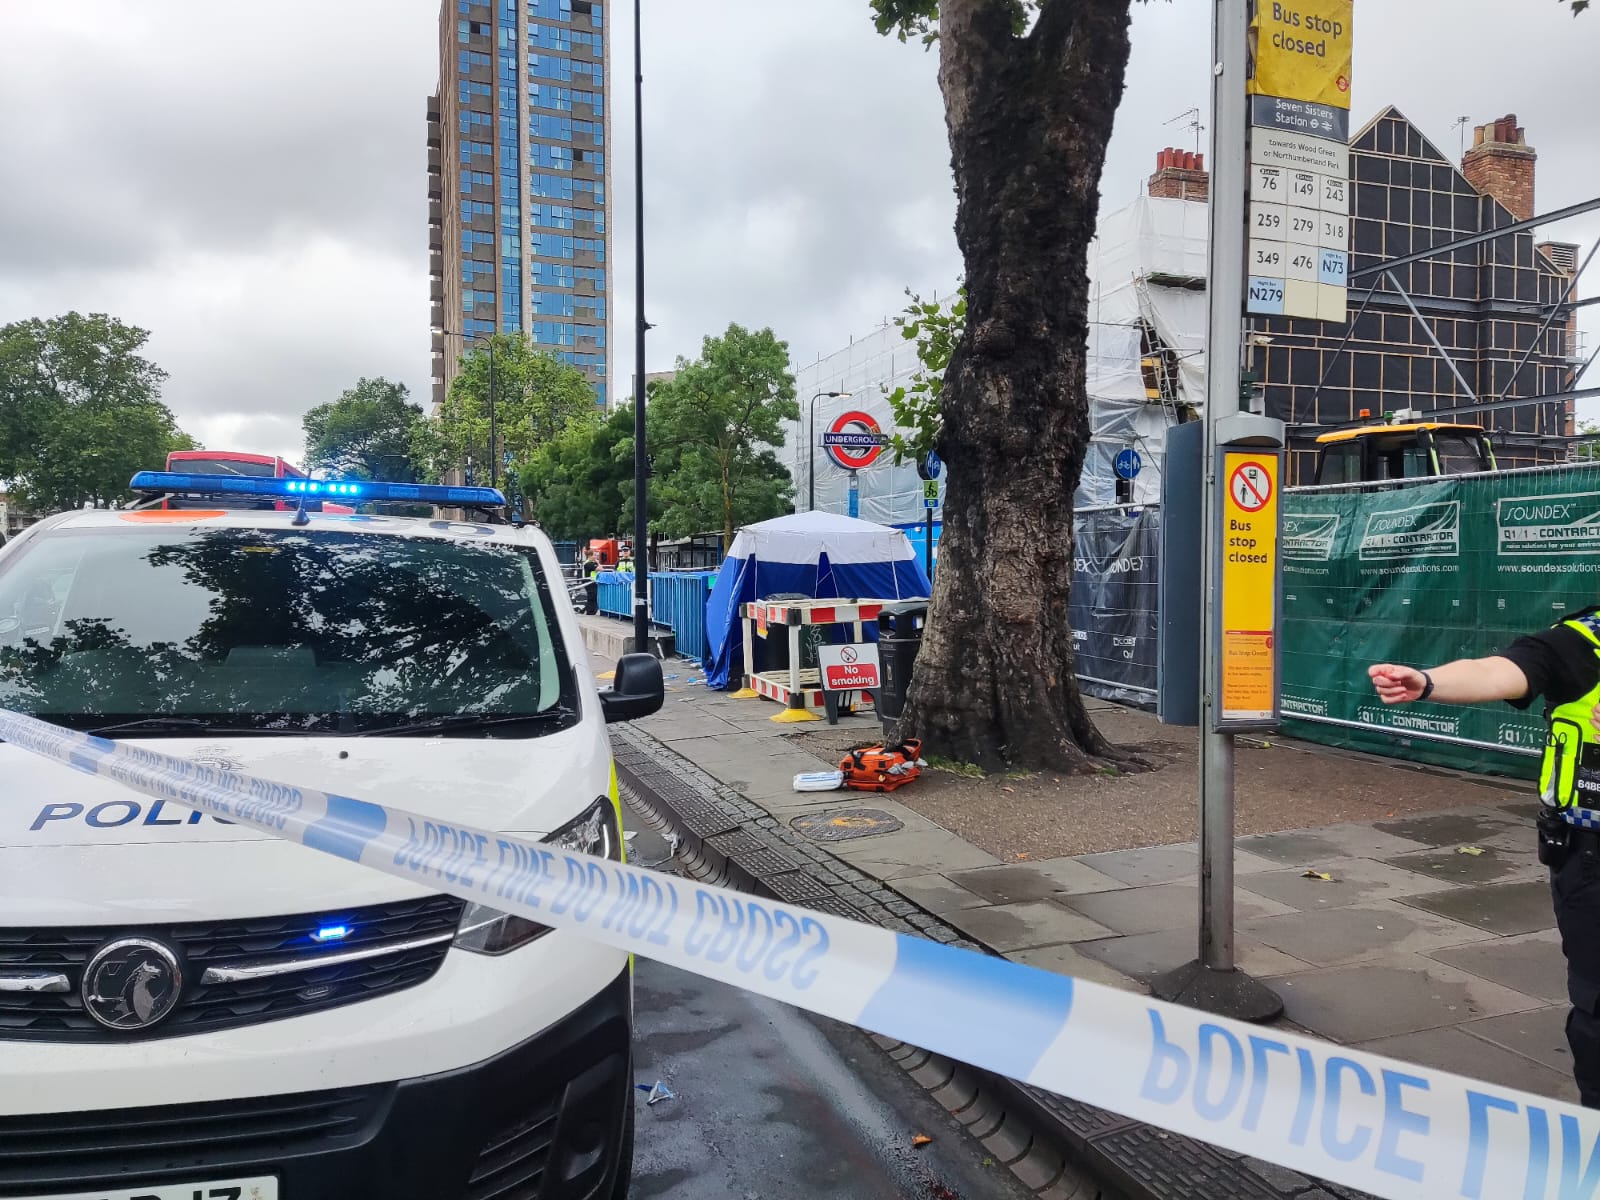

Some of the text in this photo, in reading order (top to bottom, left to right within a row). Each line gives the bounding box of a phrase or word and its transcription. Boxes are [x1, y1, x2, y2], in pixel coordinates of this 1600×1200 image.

[1272, 2, 1342, 40] Bus stop
[1272, 30, 1326, 57] closed
[1276, 98, 1333, 120] Seven Sisters
[1275, 112, 1308, 127] Station
[1269, 139, 1296, 150] towards
[1298, 144, 1316, 153] Wood
[1273, 151, 1326, 166] Northumberland
[1262, 176, 1277, 190] 76
[1294, 182, 1314, 196] 149
[1326, 187, 1344, 202] 243
[1258, 214, 1280, 228] 259
[1293, 218, 1314, 232] 279
[1326, 223, 1344, 238] 318
[1256, 250, 1280, 264] 349
[1292, 256, 1312, 269] 476
[1322, 260, 1344, 274] N73
[1250, 287, 1283, 302] N279
[826, 436, 880, 444] UNDERGROU
[1230, 520, 1252, 531] Bus
[1372, 514, 1416, 532] SOUNDEX
[1230, 536, 1256, 550] stop
[1394, 532, 1454, 544] CONTRATOR
[1229, 552, 1268, 564] closed
[844, 666, 858, 674] No
[832, 676, 874, 686] smoking
[1392, 715, 1454, 733] CONTRACTOR
[29, 800, 238, 831] POLI
